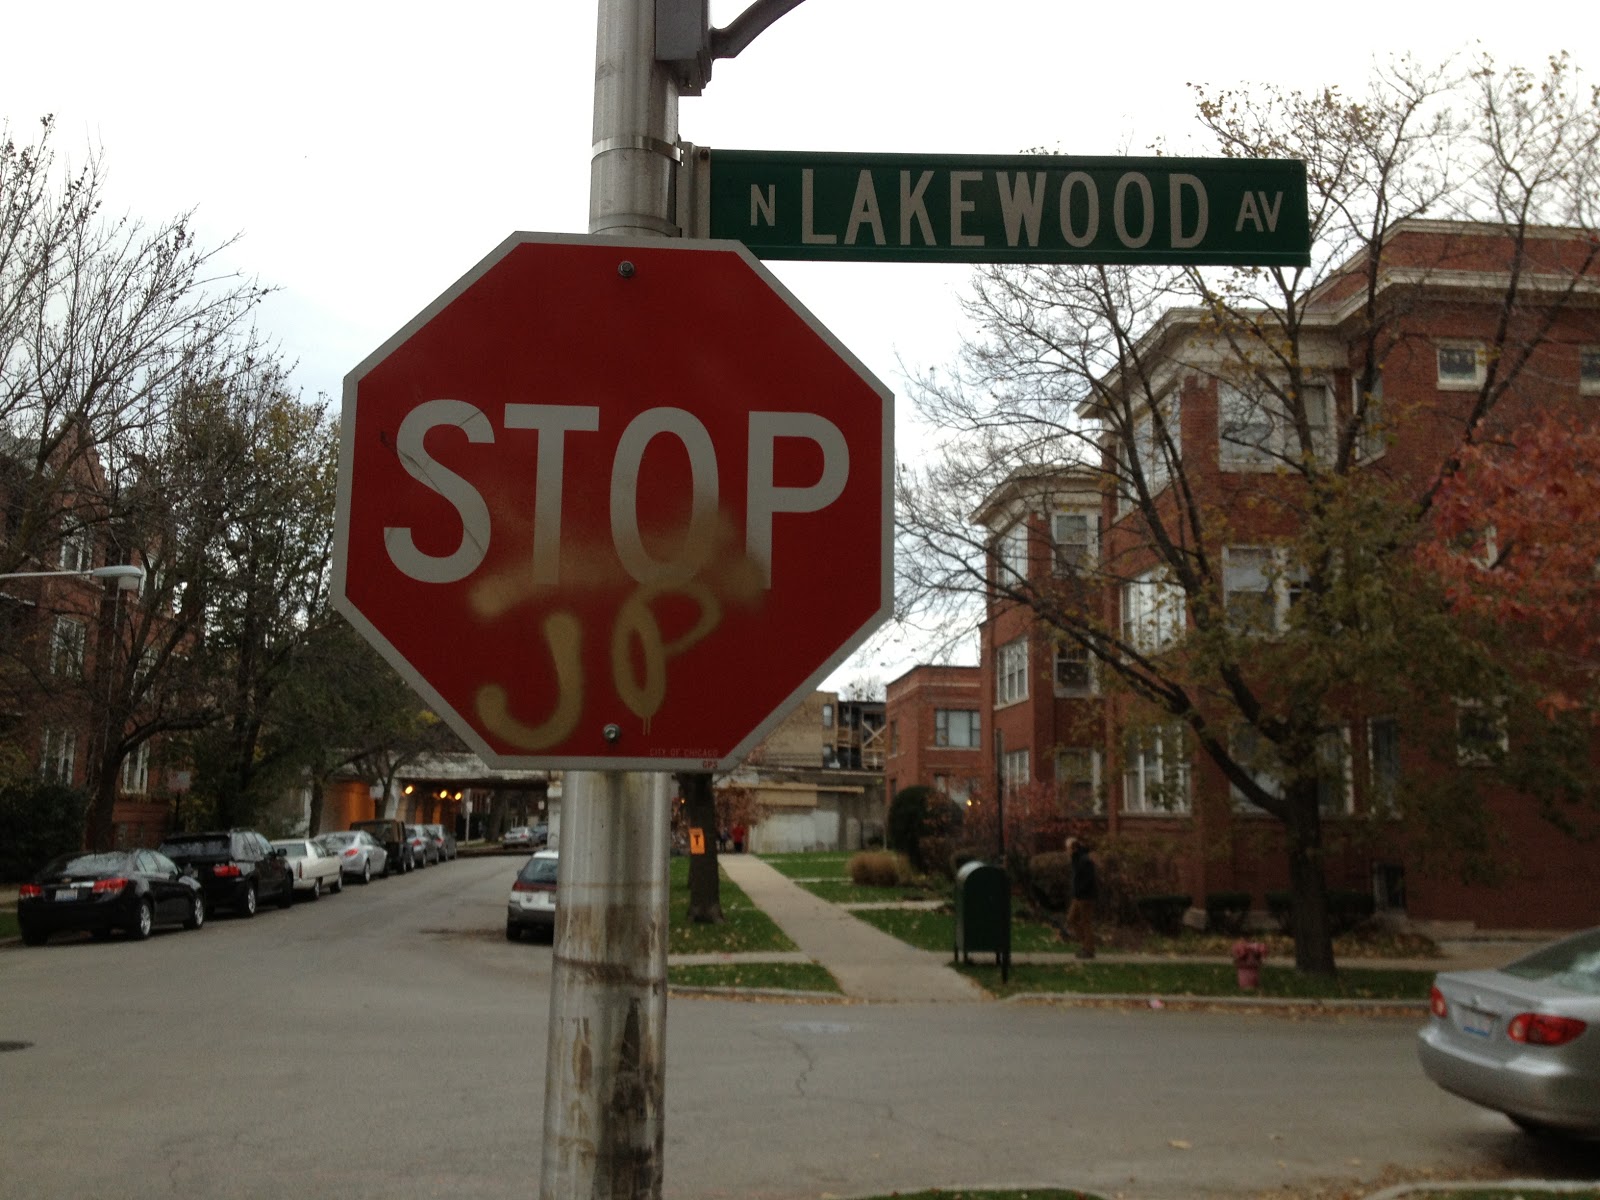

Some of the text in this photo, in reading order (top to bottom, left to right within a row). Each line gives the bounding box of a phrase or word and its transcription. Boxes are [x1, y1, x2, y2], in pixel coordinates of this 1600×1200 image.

[750, 168, 1283, 249] N LAKEWOOD AV
[383, 399, 850, 589] STOP
[649, 748, 719, 758] CITY OF CHICAGO
